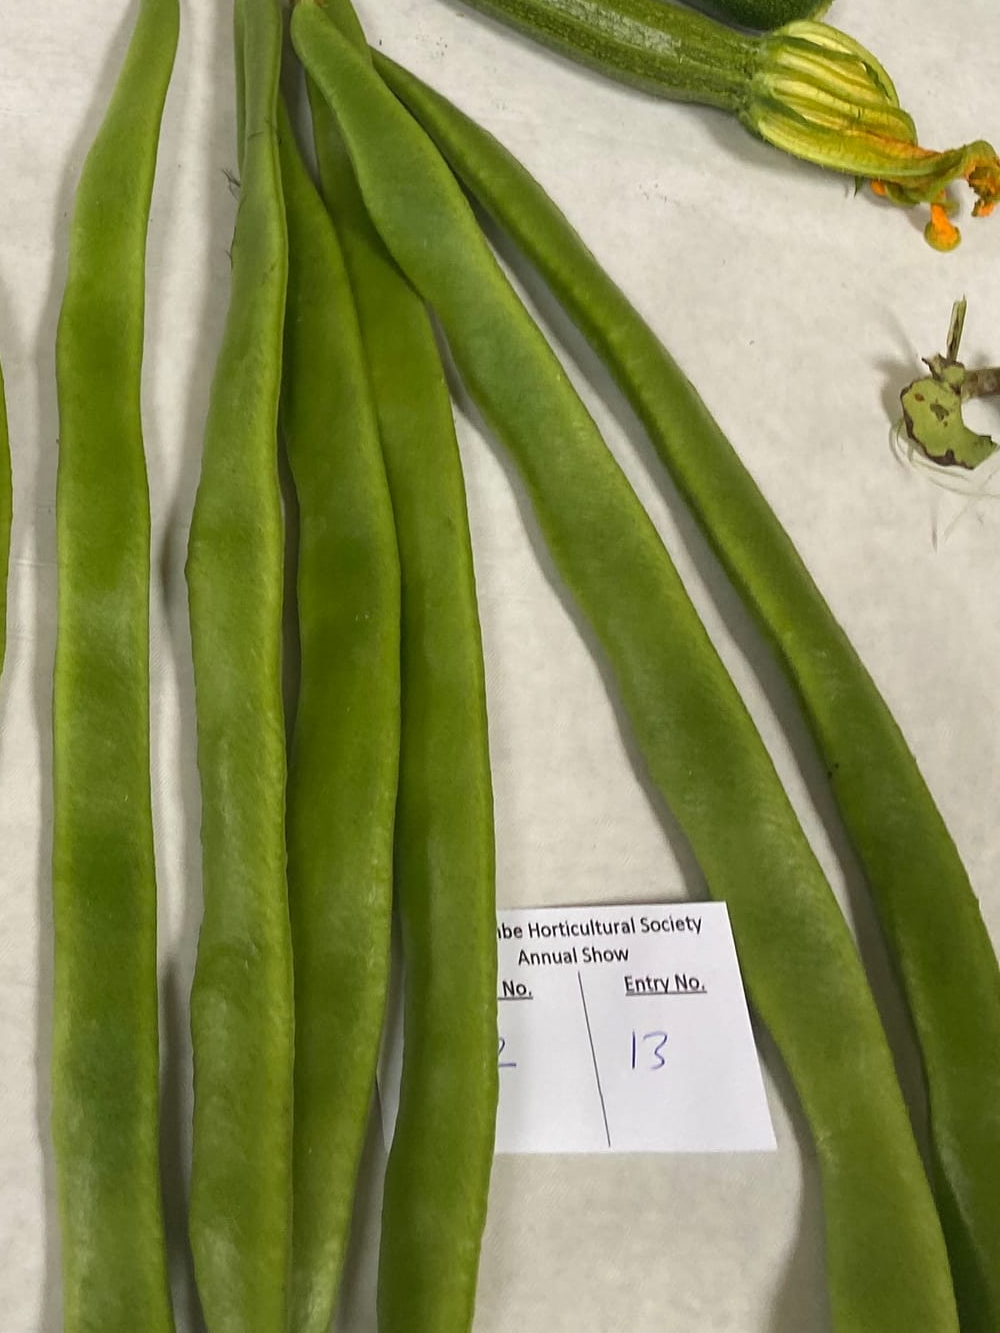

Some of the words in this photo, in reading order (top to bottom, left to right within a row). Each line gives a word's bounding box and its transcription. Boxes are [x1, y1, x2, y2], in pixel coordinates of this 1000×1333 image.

[528, 917, 635, 938] Horticultural
[641, 915, 702, 935] Society
[518, 947, 577, 966] Annual
[583, 947, 629, 964] Show
[502, 980, 532, 998] No.
[624, 976, 669, 995] Entry
[676, 974, 706, 993] No.
[631, 1031, 668, 1070] 13
